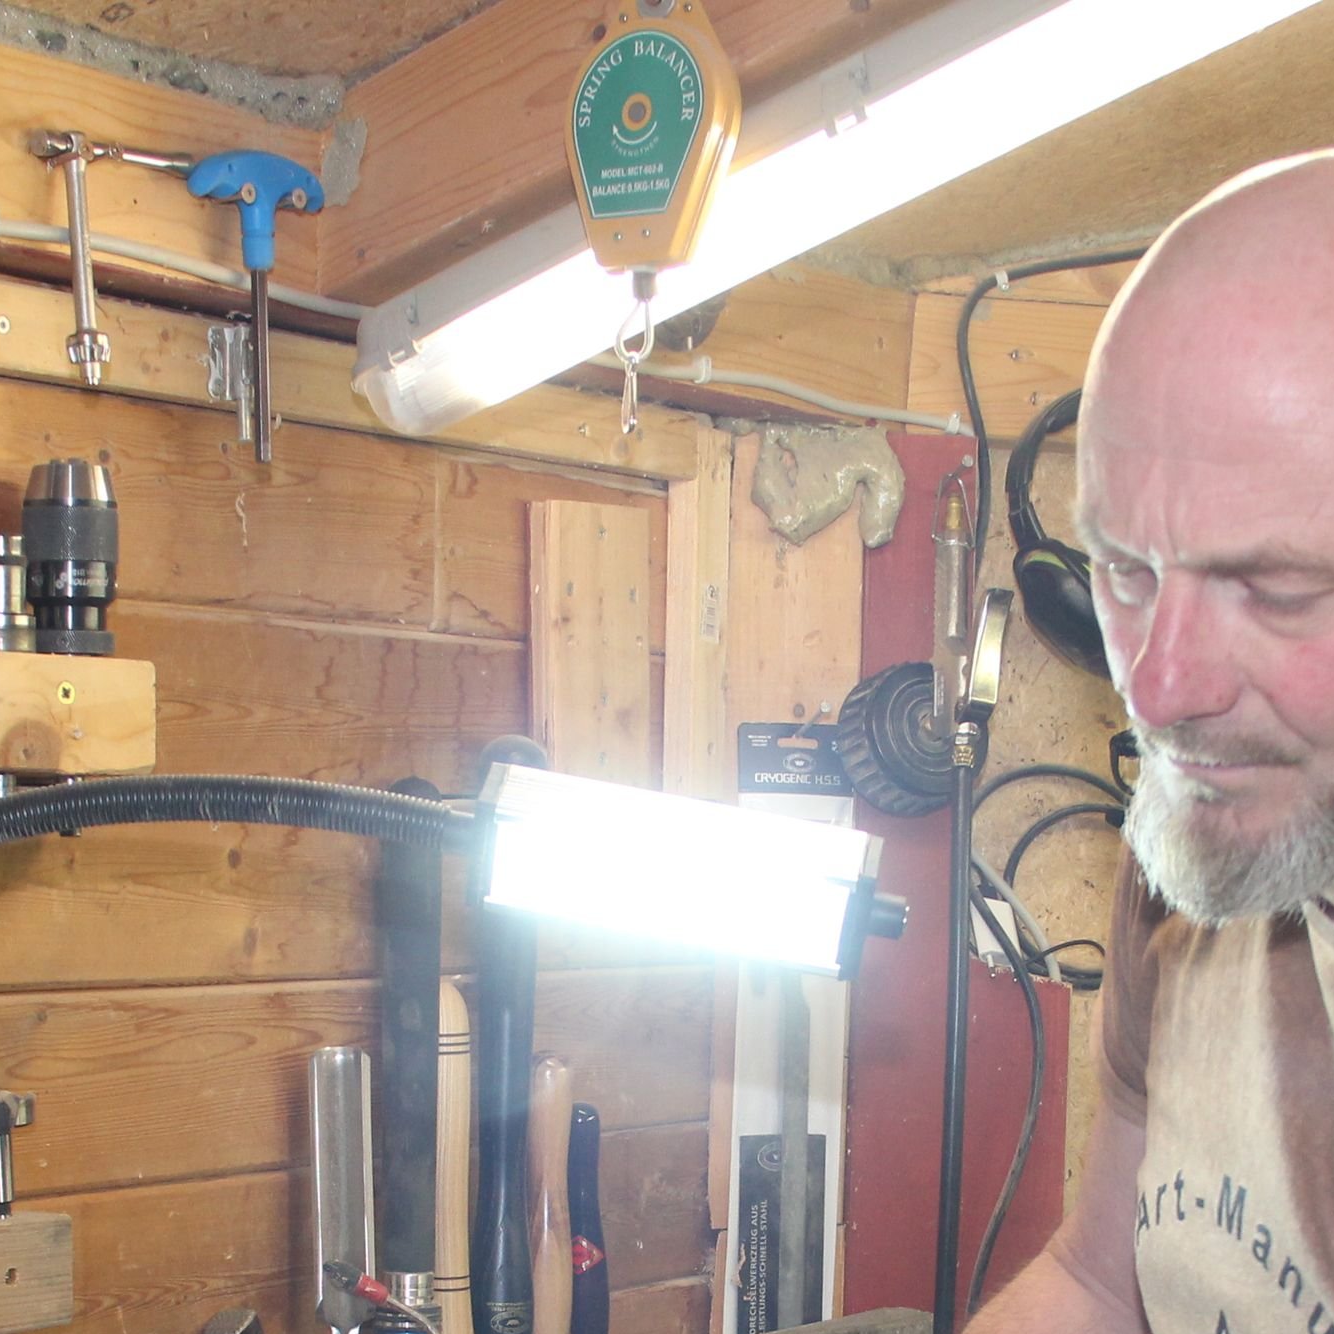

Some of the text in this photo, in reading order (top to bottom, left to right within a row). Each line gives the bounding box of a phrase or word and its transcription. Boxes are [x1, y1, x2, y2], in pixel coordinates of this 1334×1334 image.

[578, 39, 696, 128] SPRING BALANCER
[754, 772, 812, 784] CRYOGENIC
[750, 1203, 759, 1221] AUS
